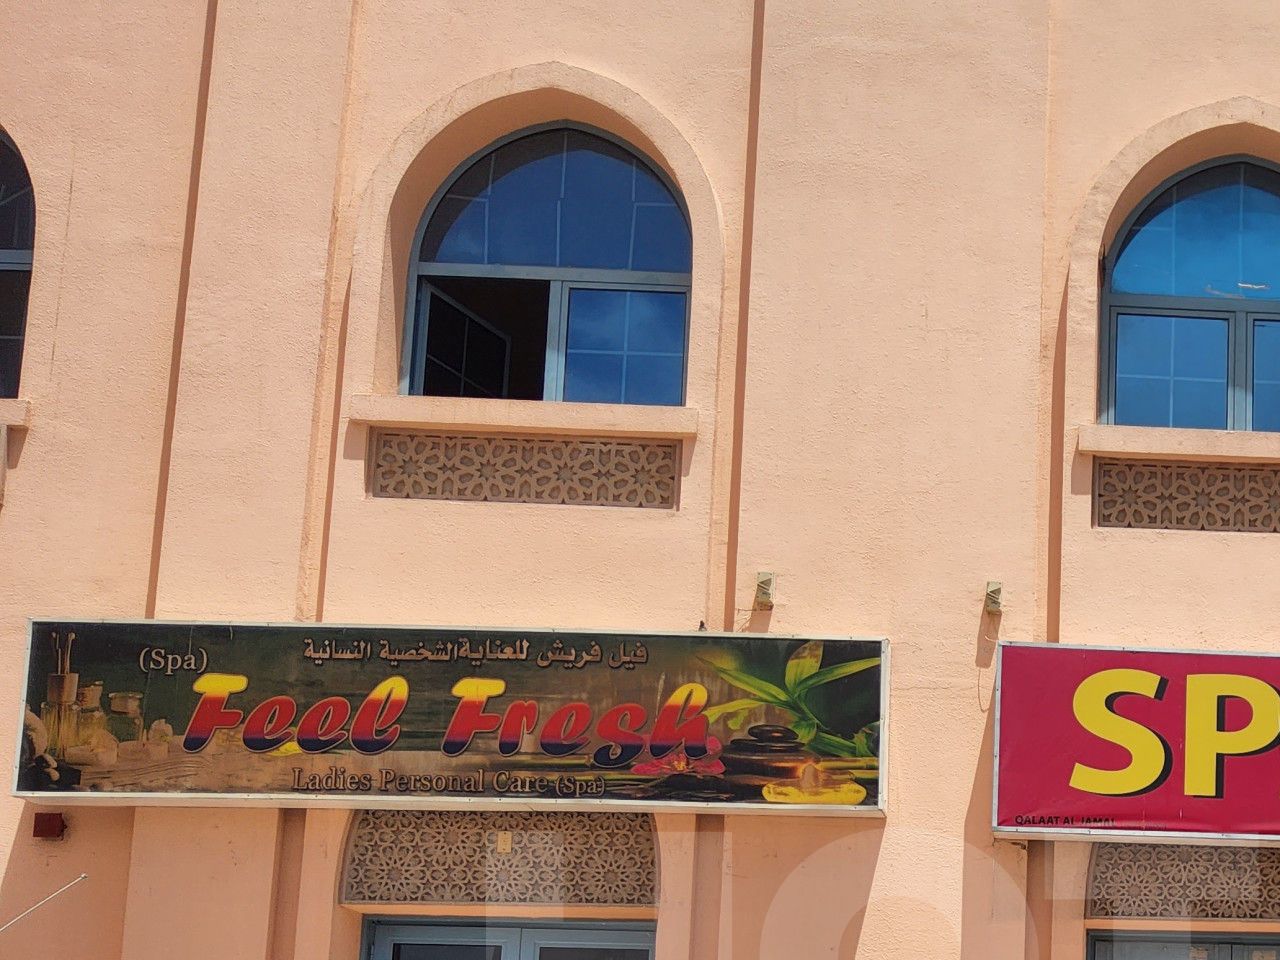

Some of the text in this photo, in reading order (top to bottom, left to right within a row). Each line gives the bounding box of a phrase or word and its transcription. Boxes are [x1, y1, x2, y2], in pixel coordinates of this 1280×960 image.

[140, 647, 208, 675] (Spa)
[536, 639, 602, 669] فريش
[608, 640, 649, 670] فيل
[182, 672, 710, 768] Feel Fresh
[291, 766, 606, 797] Ladies Personal Care (Spa)
